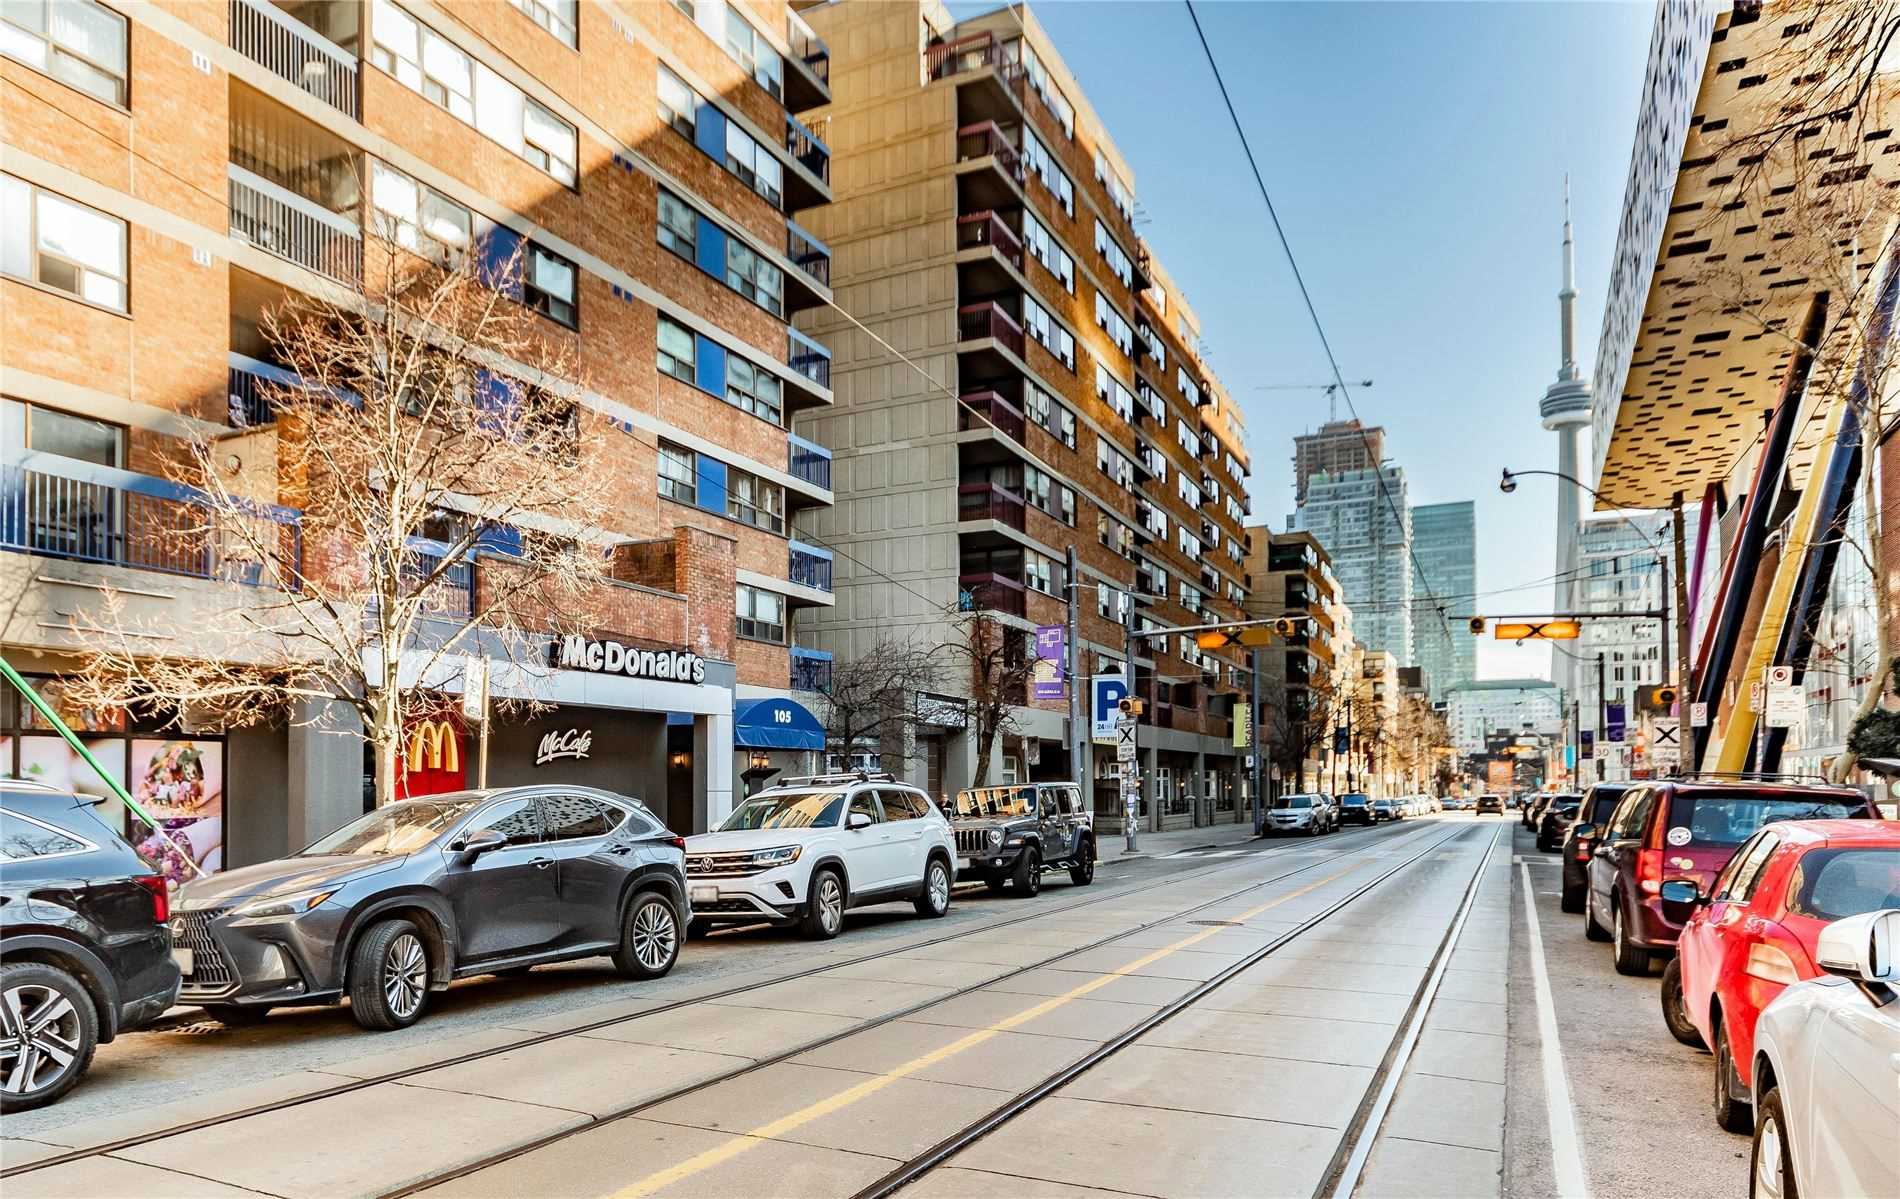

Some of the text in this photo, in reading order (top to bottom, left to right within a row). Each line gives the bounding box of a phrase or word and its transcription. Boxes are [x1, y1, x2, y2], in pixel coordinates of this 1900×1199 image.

[561, 634, 705, 683] McDonald's
[774, 709, 792, 724] 105
[1097, 681, 1128, 721] P
